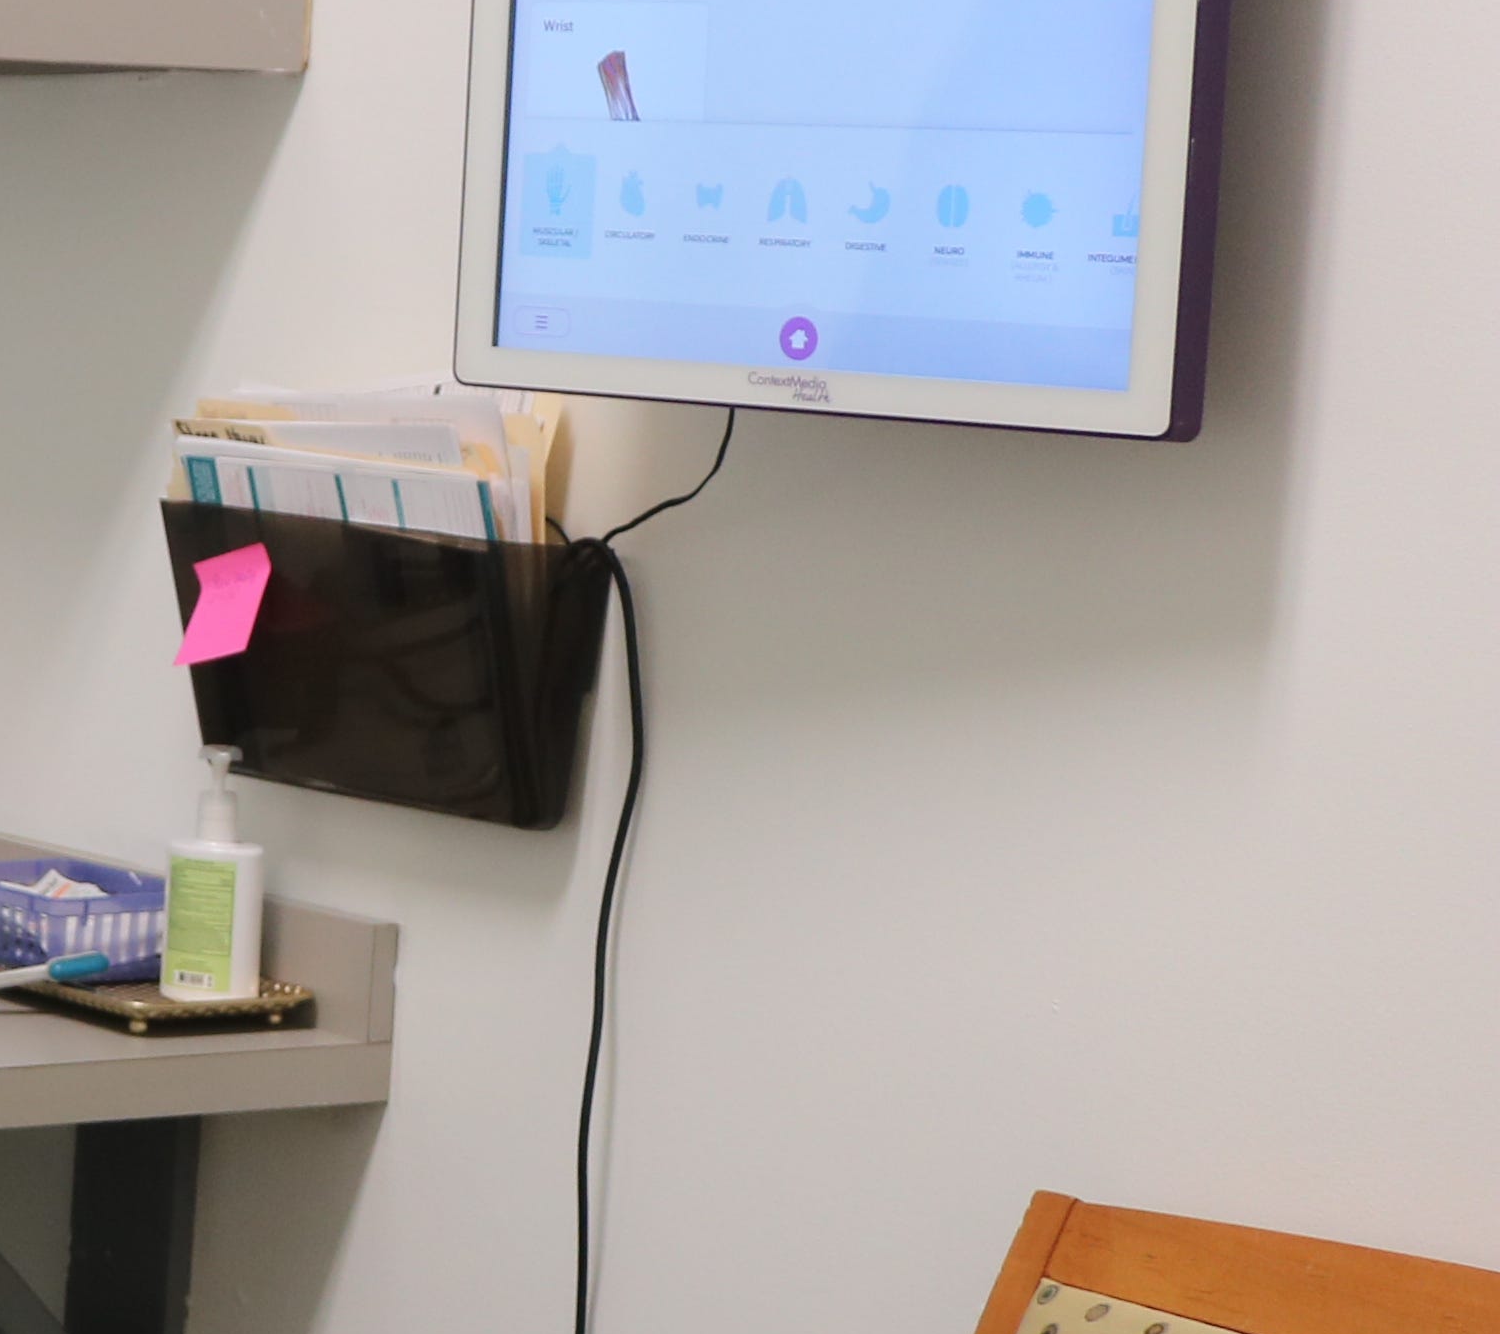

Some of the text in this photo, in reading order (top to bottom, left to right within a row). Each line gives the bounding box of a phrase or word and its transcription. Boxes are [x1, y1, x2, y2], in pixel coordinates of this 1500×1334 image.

[543, 19, 574, 33] Wrist
[845, 242, 887, 253] DIGESTIVE
[934, 246, 965, 256] NEURO
[1016, 250, 1055, 261] IMMUNE
